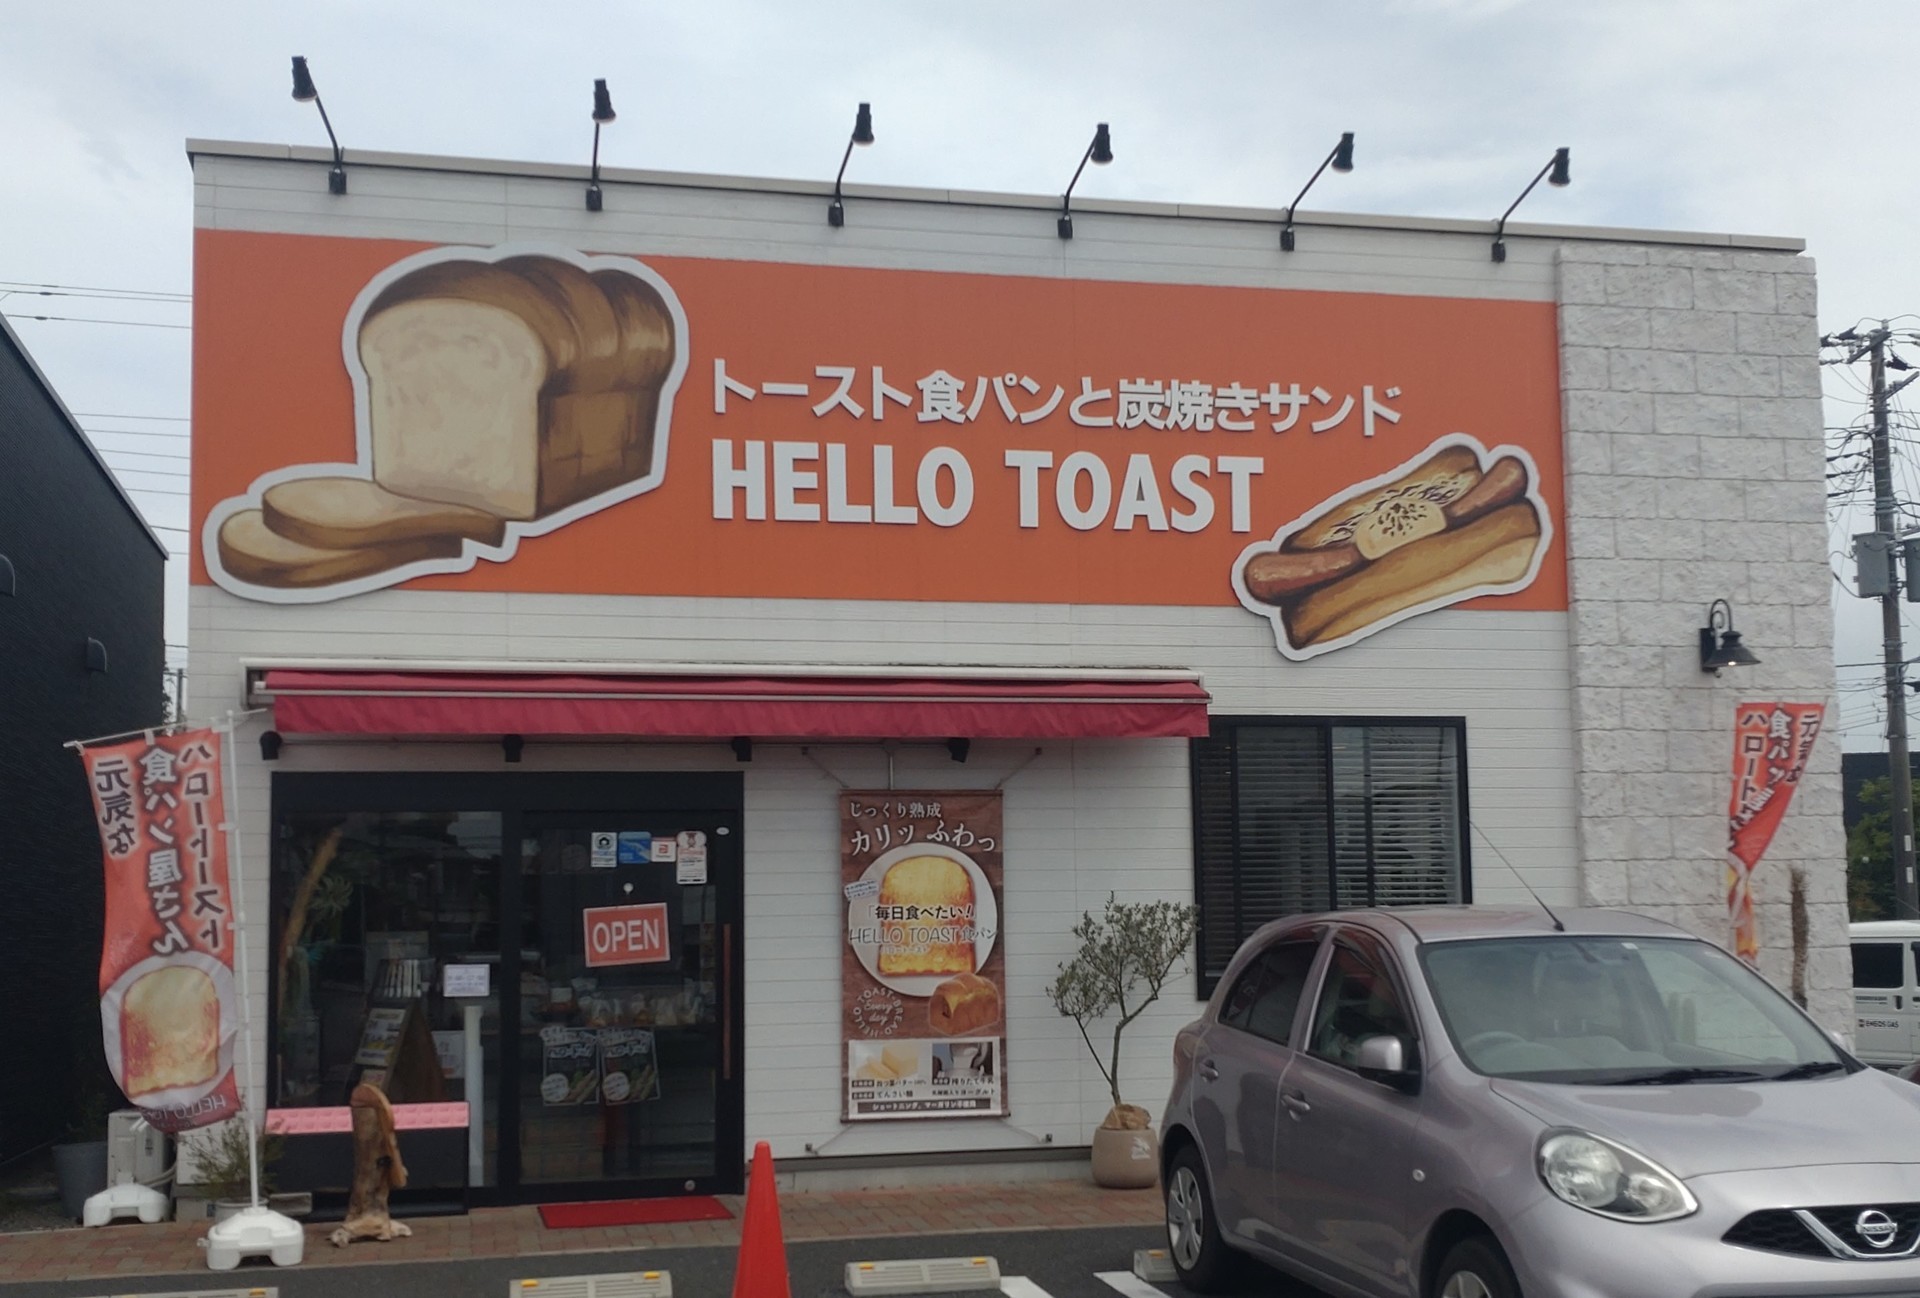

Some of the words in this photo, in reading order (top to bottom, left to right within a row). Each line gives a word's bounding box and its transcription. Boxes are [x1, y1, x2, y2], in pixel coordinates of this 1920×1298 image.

[712, 357, 1402, 438] トースト食パンと炭焼きサンド
[711, 438, 974, 527] HELLO
[1004, 449, 1265, 533] TOAST
[850, 802, 942, 818] じっくり熟成
[592, 918, 661, 954] OPEN
[849, 927, 903, 945] HELLO
[909, 926, 960, 944] TOAST
